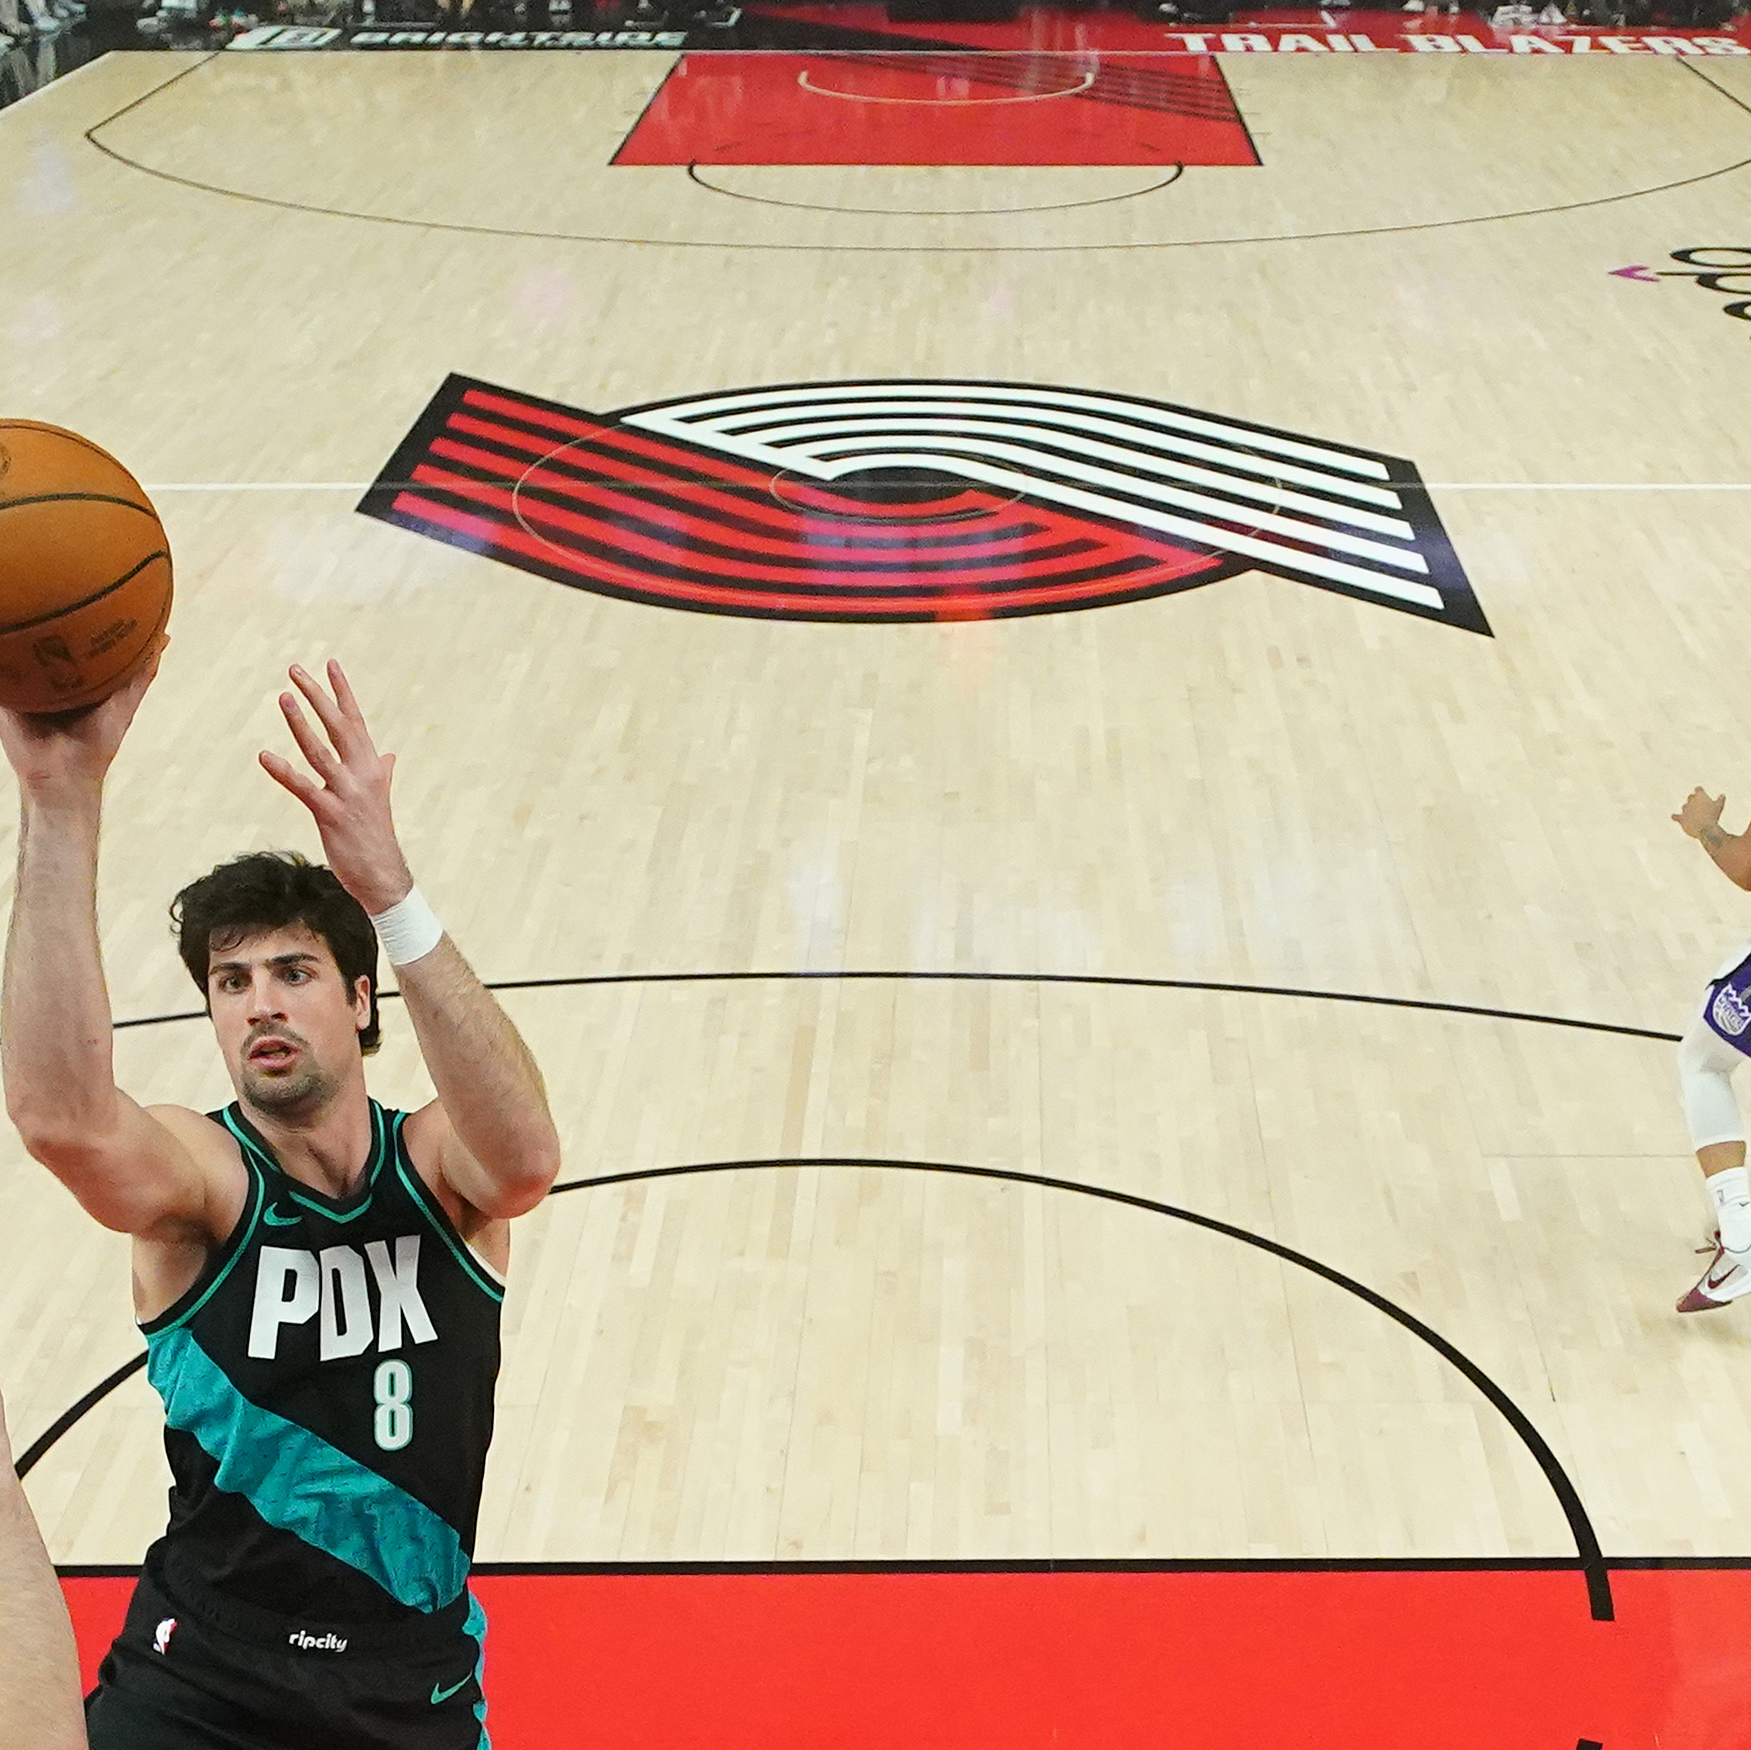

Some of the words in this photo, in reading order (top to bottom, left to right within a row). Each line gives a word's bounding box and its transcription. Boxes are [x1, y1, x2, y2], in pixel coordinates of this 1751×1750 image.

[1165, 33, 1398, 53] TRAIL
[1401, 34, 1751, 55] BLAZERS
[248, 1234, 439, 1362] PDX
[373, 1359, 414, 1451] 8
[289, 1630, 348, 1654] ripcity
